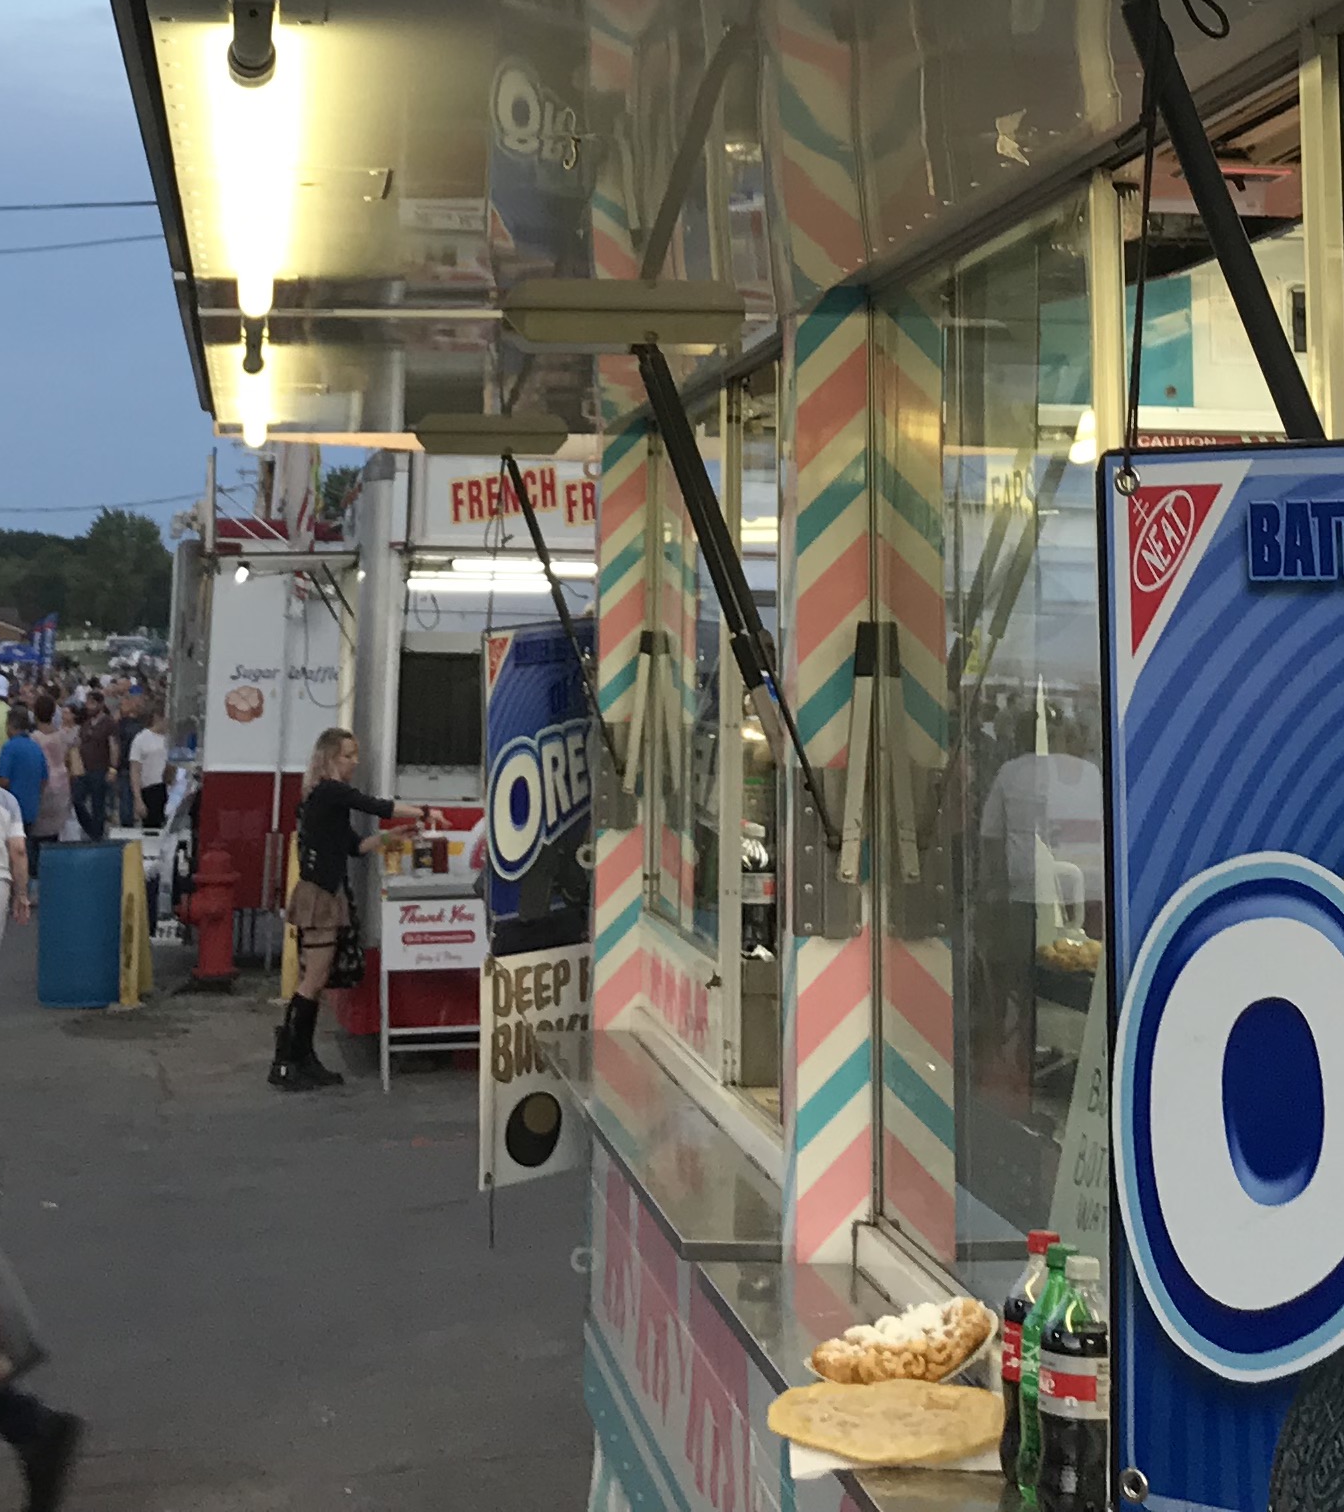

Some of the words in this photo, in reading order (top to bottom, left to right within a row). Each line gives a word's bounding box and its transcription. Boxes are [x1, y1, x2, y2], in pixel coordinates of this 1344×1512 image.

[1137, 435, 1217, 448] CAUTION
[451, 467, 557, 523] FRENCH
[1140, 498, 1189, 582] NEAT
[399, 903, 445, 925] Thank
[492, 958, 571, 1018] DEEP
